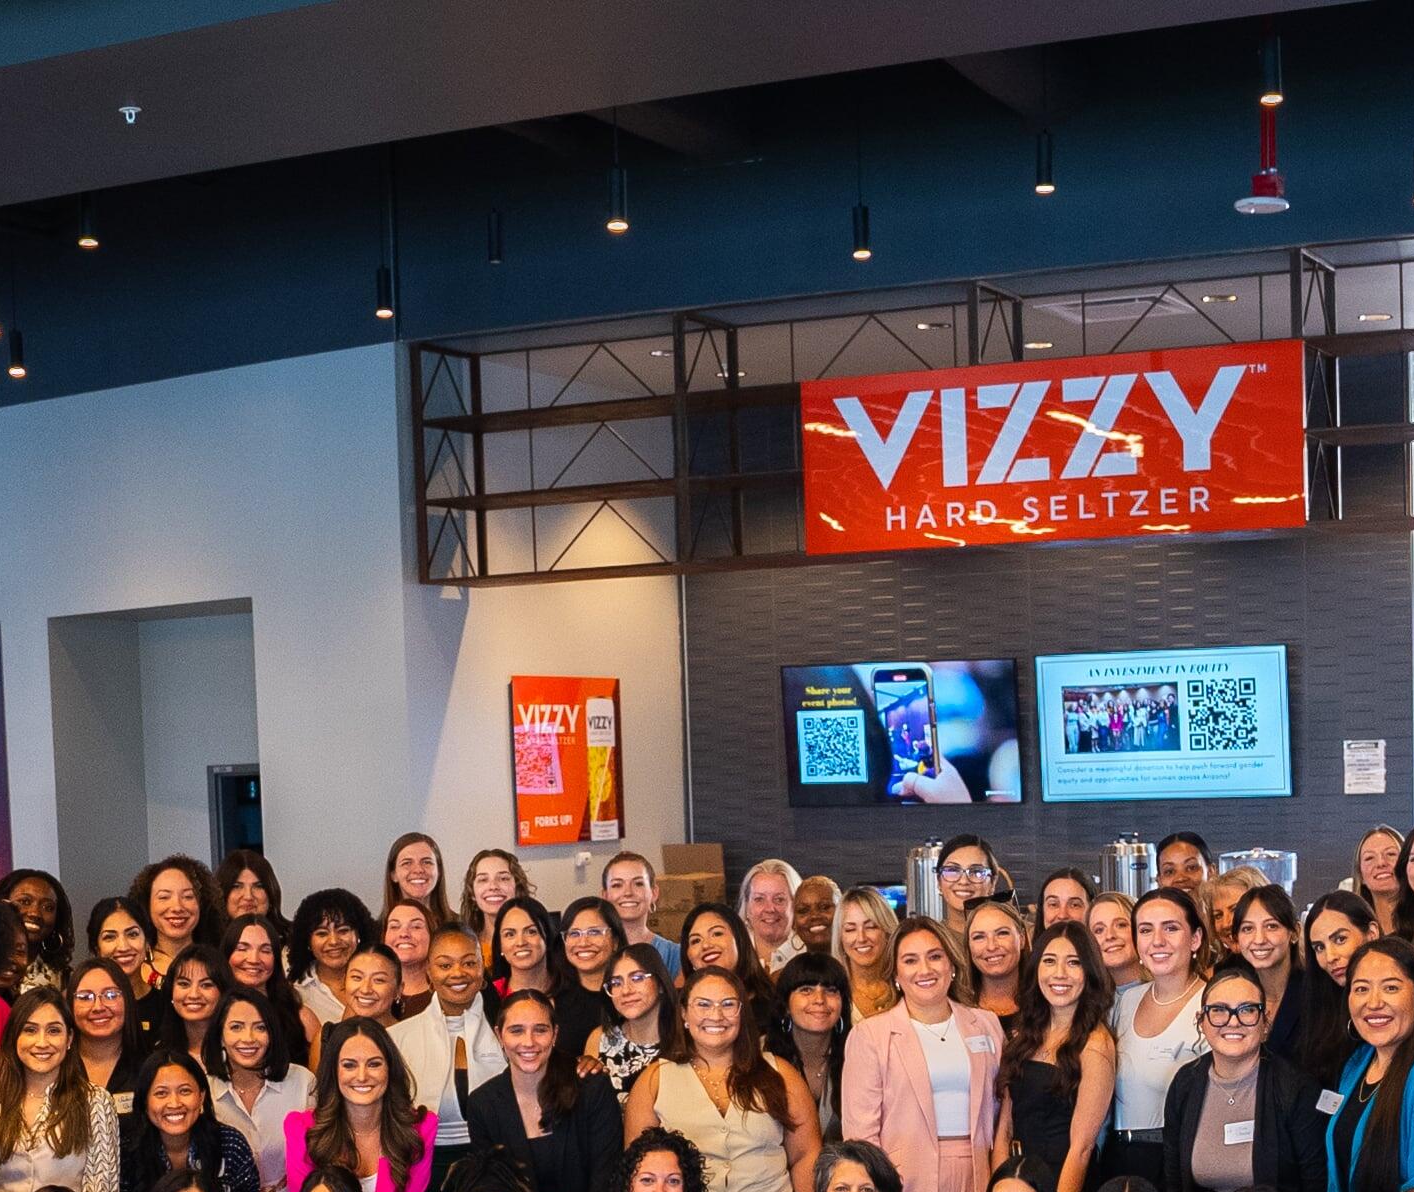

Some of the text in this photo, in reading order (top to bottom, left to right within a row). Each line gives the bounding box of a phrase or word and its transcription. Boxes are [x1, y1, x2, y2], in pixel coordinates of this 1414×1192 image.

[886, 486, 1211, 531] HARD SELTZER
[517, 703, 580, 733] VIZZY
